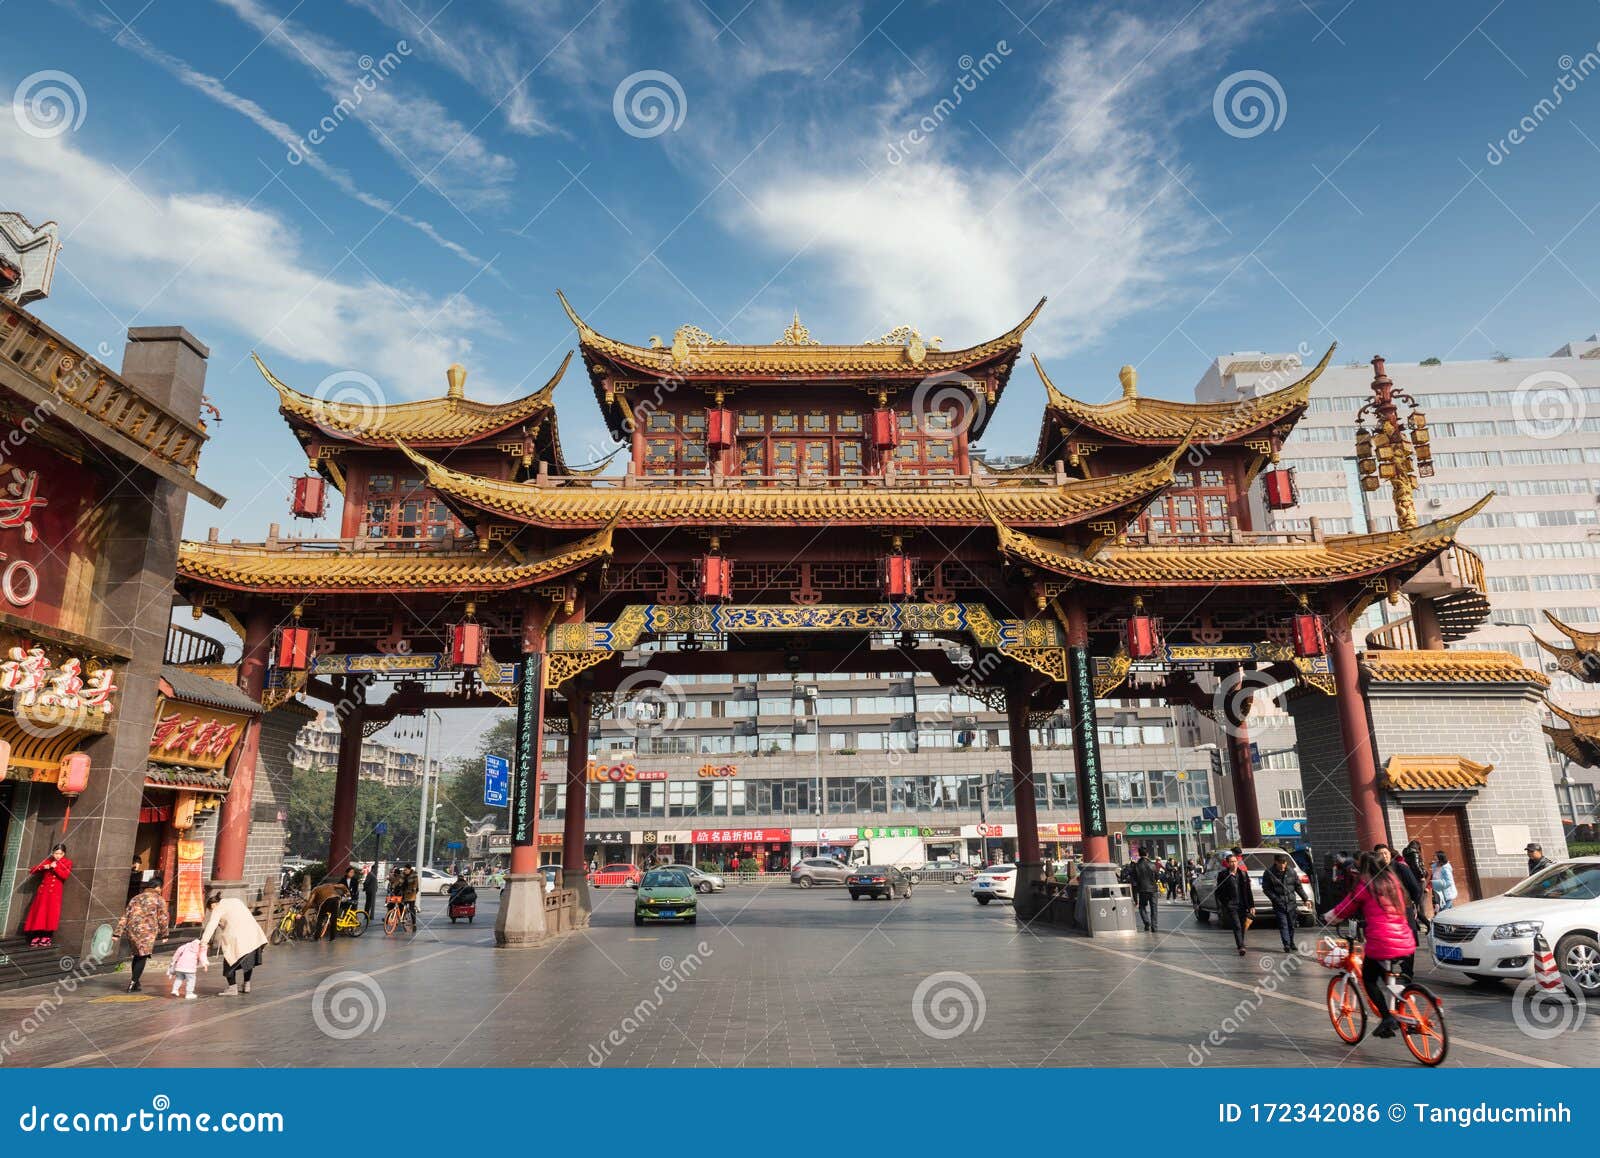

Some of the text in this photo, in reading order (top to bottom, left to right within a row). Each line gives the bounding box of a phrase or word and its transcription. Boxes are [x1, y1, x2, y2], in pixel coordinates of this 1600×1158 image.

[586, 762, 637, 782] ico's
[711, 831, 764, 842] 名品折扣店
